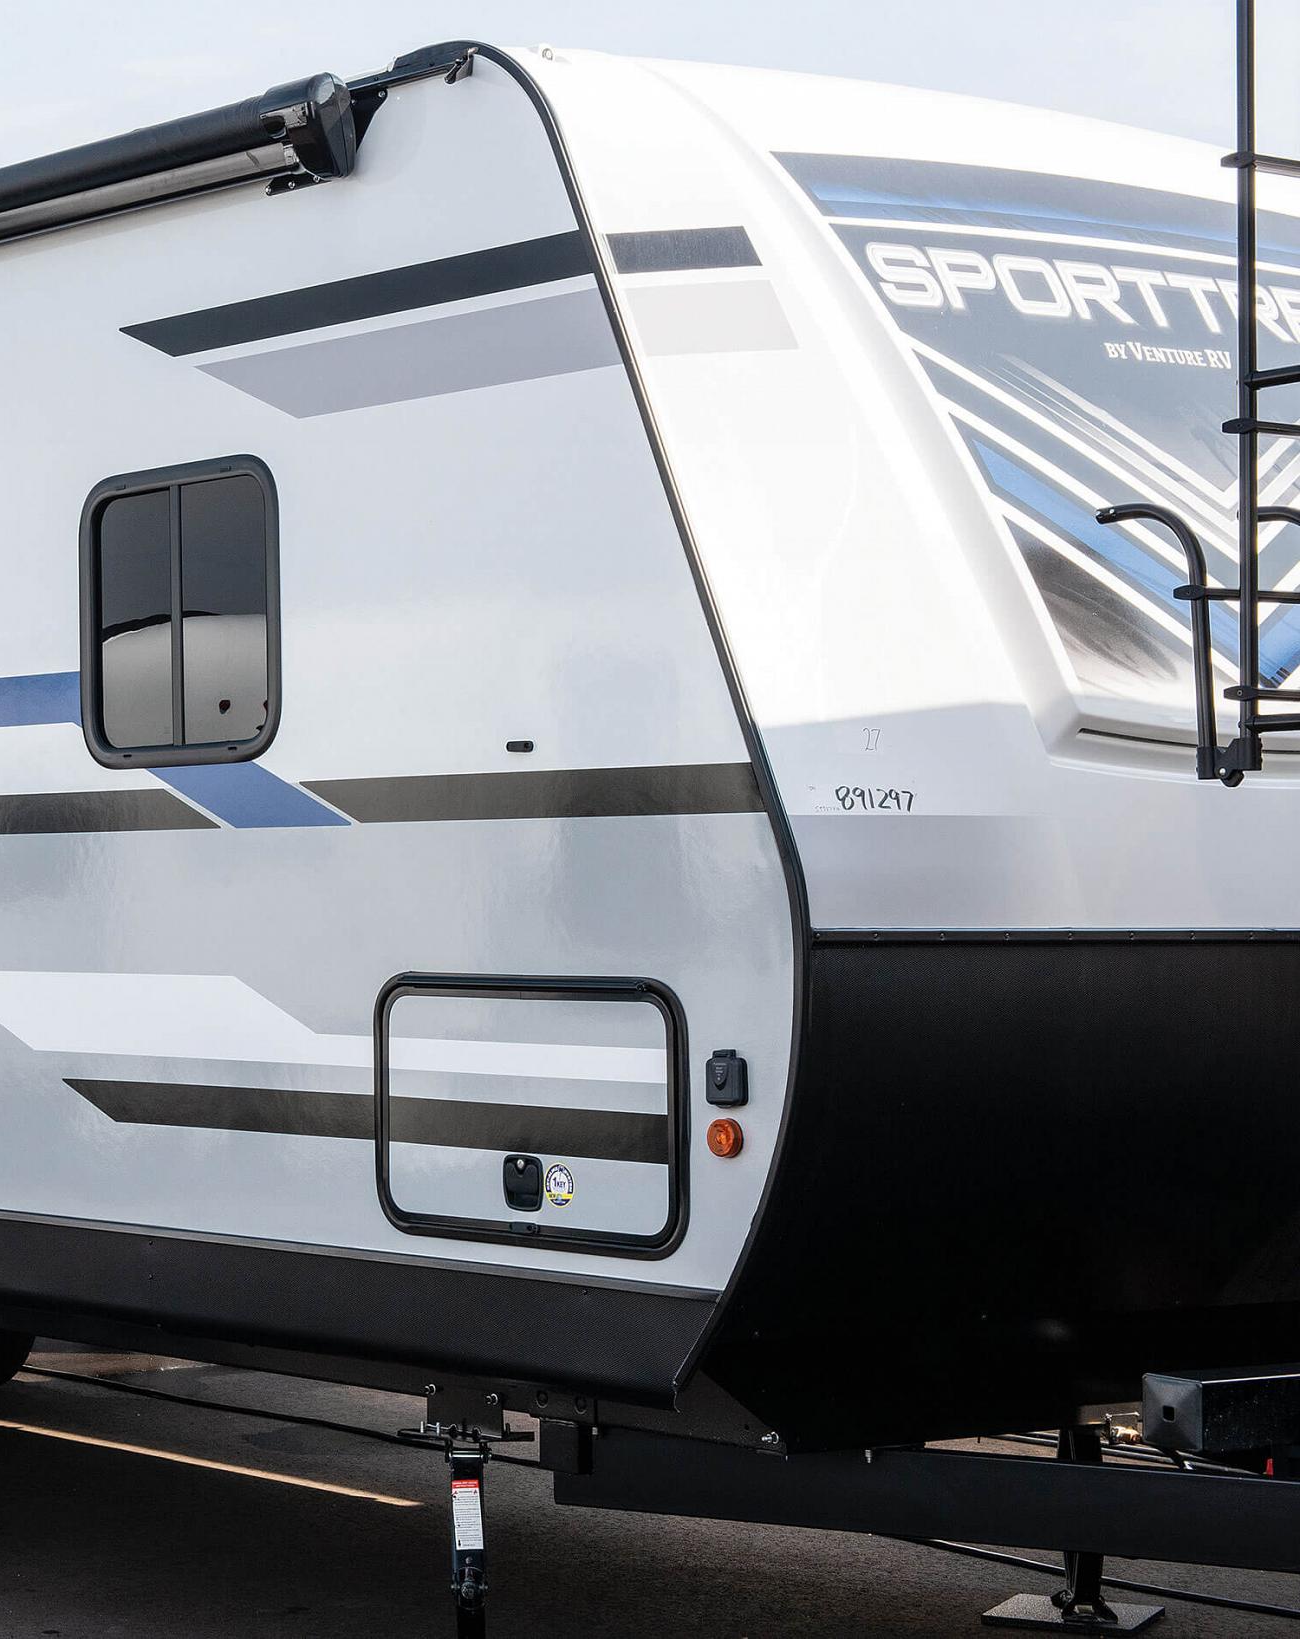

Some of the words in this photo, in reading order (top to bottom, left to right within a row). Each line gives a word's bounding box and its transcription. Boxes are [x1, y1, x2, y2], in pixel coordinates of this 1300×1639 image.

[1103, 342, 1128, 359] BY
[1204, 349, 1232, 369] RV
[862, 727, 881, 752] 27
[835, 785, 915, 813] 891297
